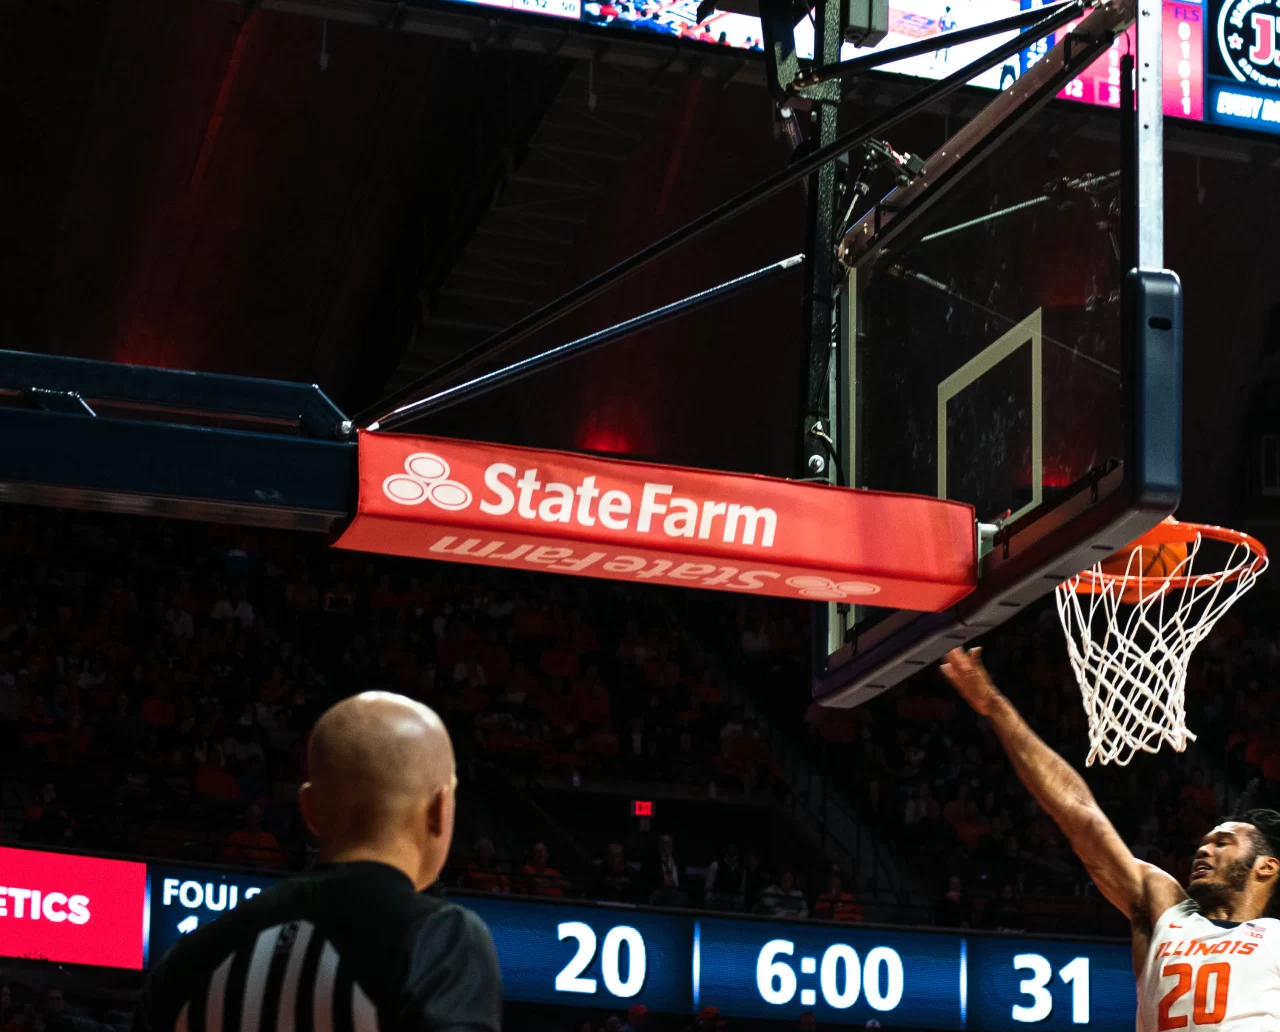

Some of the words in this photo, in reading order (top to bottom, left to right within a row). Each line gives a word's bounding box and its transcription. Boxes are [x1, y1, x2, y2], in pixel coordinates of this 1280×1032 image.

[1174, 7, 1199, 20] FLS
[1155, 940, 1259, 961] ILLINOIS
[555, 921, 647, 998] 20
[756, 938, 905, 1012] 6:00
[1013, 952, 1091, 1026] 31
[1157, 962, 1232, 1032] 20
